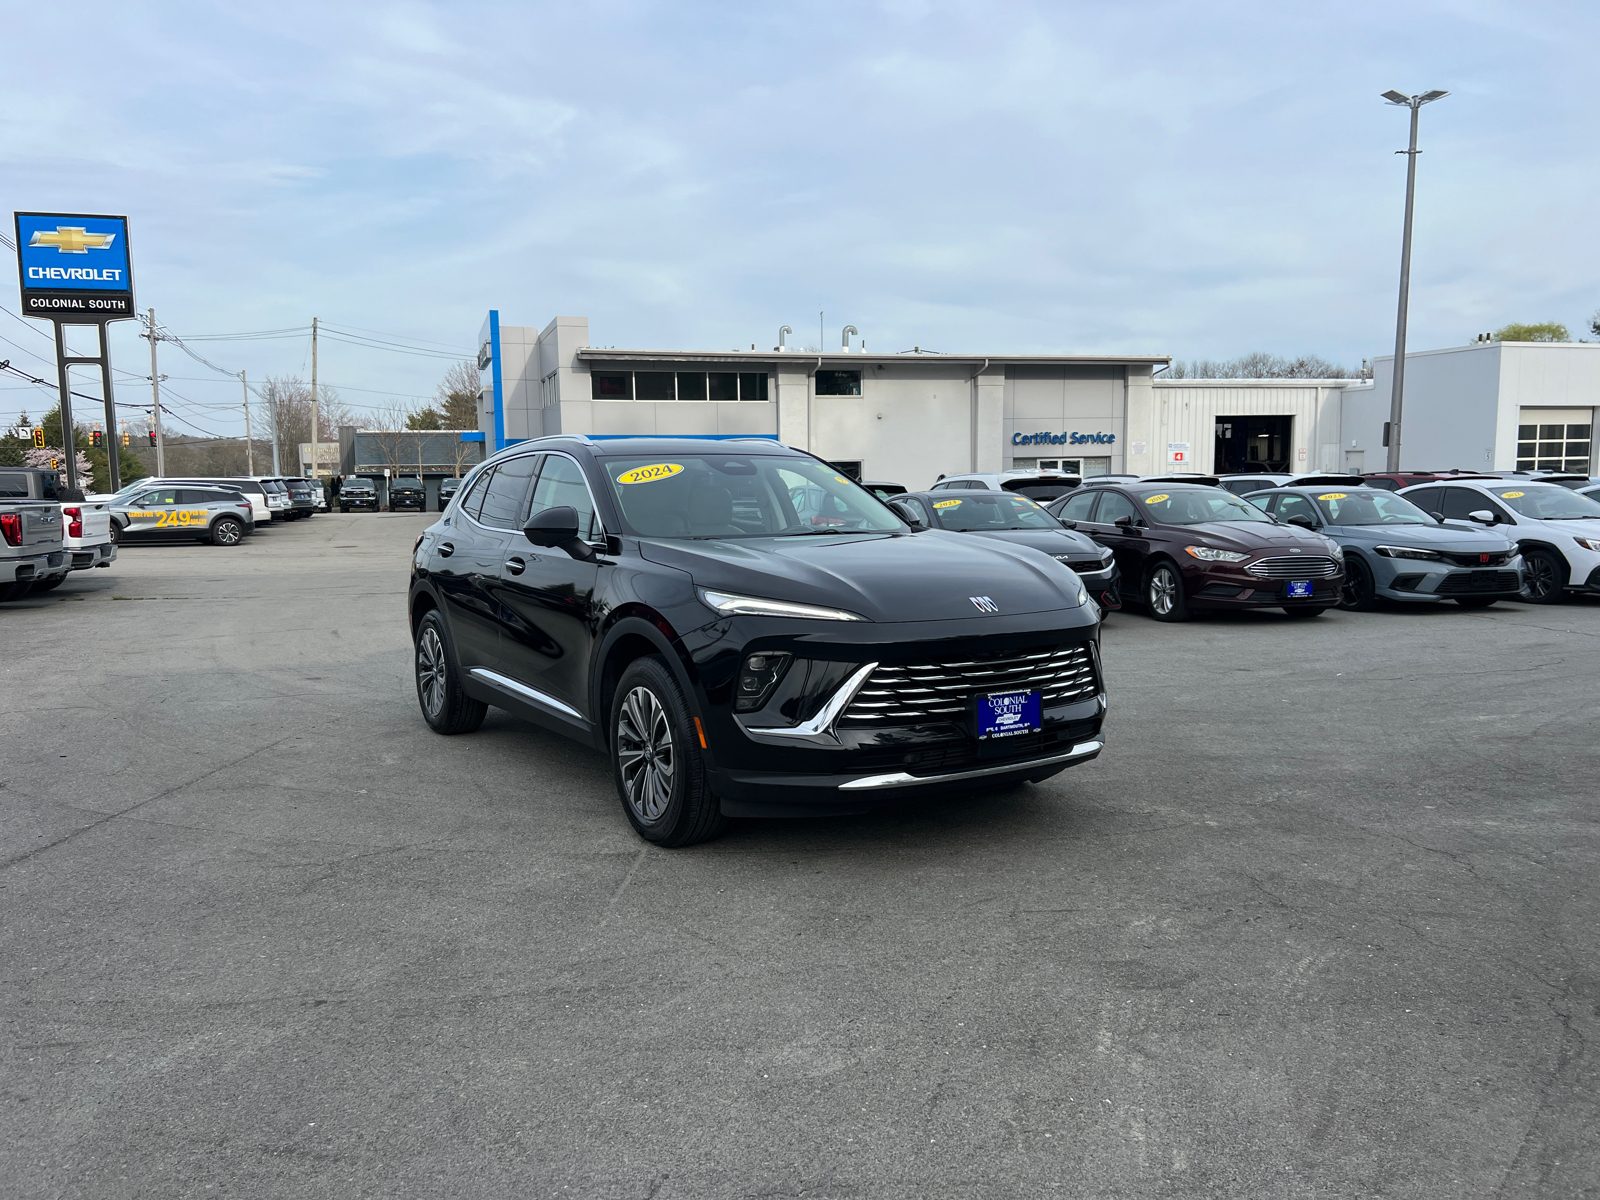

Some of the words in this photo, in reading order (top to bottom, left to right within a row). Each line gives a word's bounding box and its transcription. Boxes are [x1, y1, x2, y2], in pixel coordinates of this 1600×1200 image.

[28, 267, 122, 281] CHEVROLET
[30, 298, 85, 308] COLONIAL
[88, 300, 125, 309] SOUTH
[1012, 432, 1067, 444] Certified
[1070, 431, 1115, 444] Service
[630, 465, 673, 482] 2024
[989, 696, 1027, 707] COLONIAL
[995, 704, 1021, 714] SOUTH
